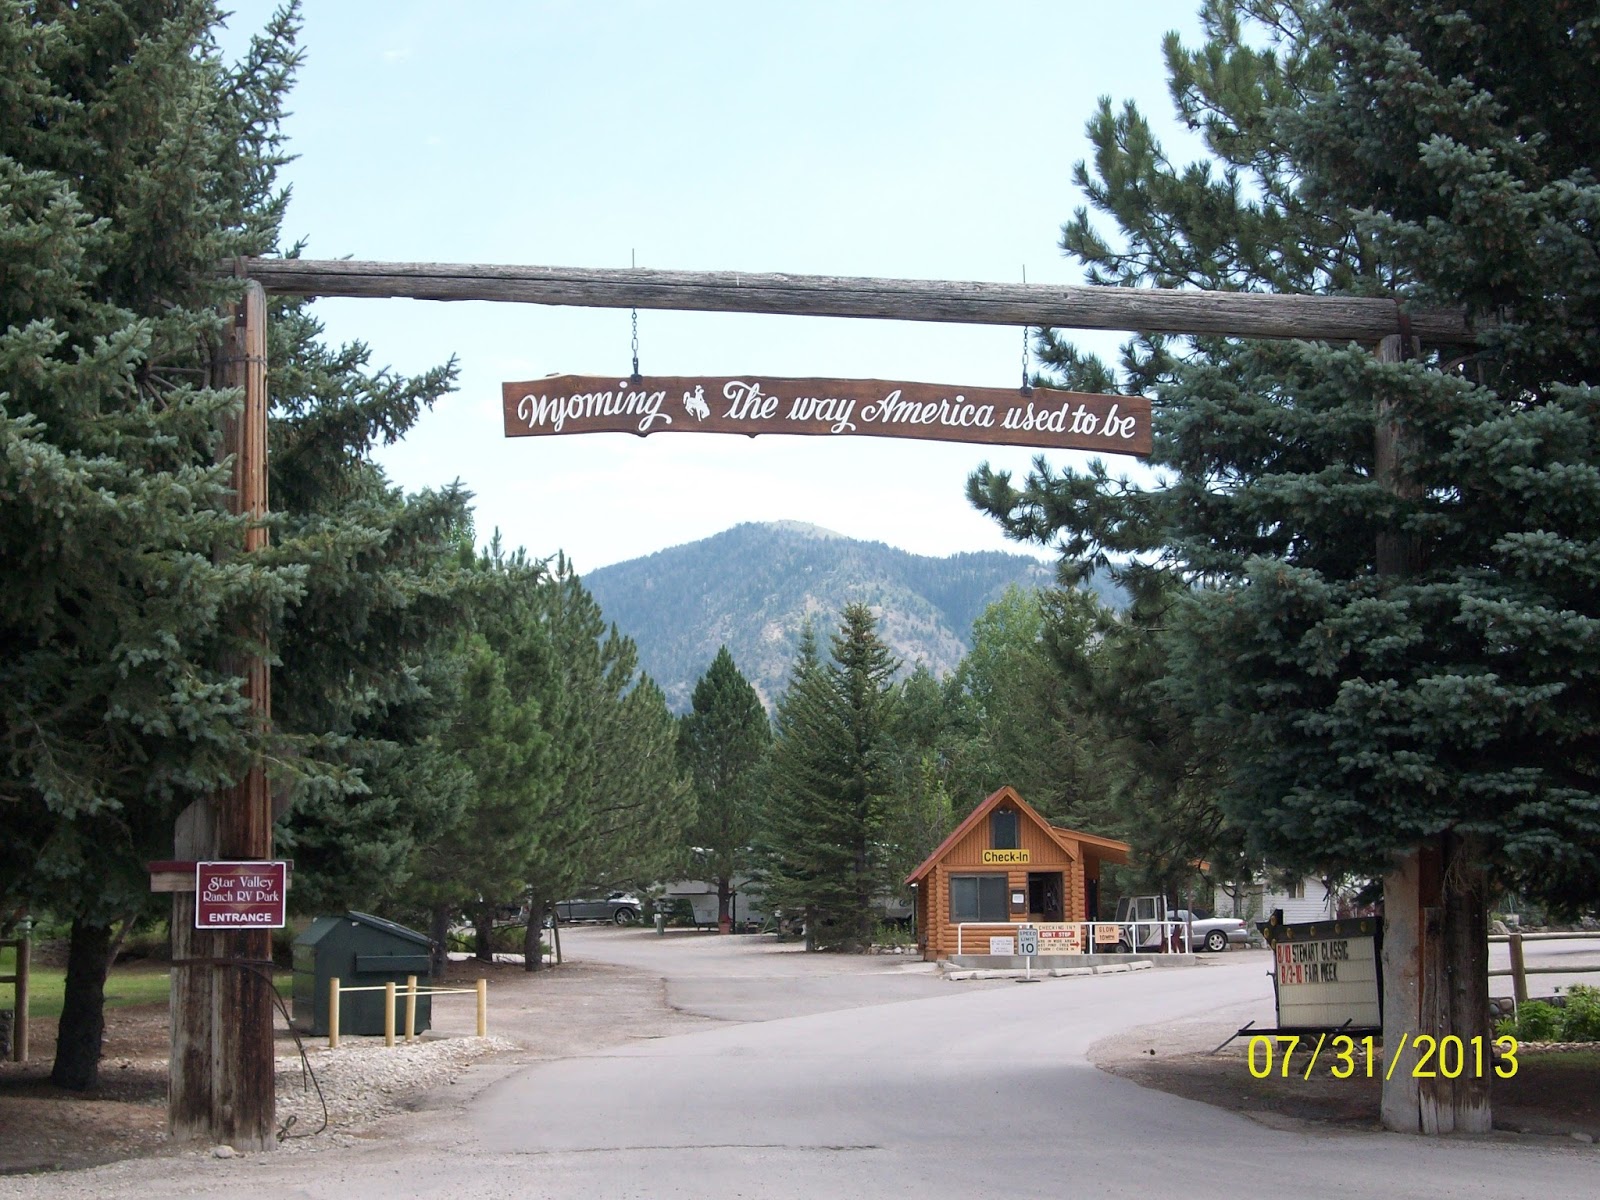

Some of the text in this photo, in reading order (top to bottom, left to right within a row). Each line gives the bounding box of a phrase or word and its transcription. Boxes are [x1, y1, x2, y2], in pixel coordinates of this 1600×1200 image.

[517, 380, 1136, 439] Wyoming The way America used to be
[984, 851, 1029, 862] Check-In
[208, 876, 274, 891] Star Valley
[203, 891, 279, 902] Ranch RV Park
[209, 913, 272, 922] ENTRANCE
[1021, 943, 1034, 953] 10
[1277, 941, 1348, 963] 8/10 STEWART CLASSIC
[1281, 962, 1338, 984] 8/3-10 FAIR WEEK
